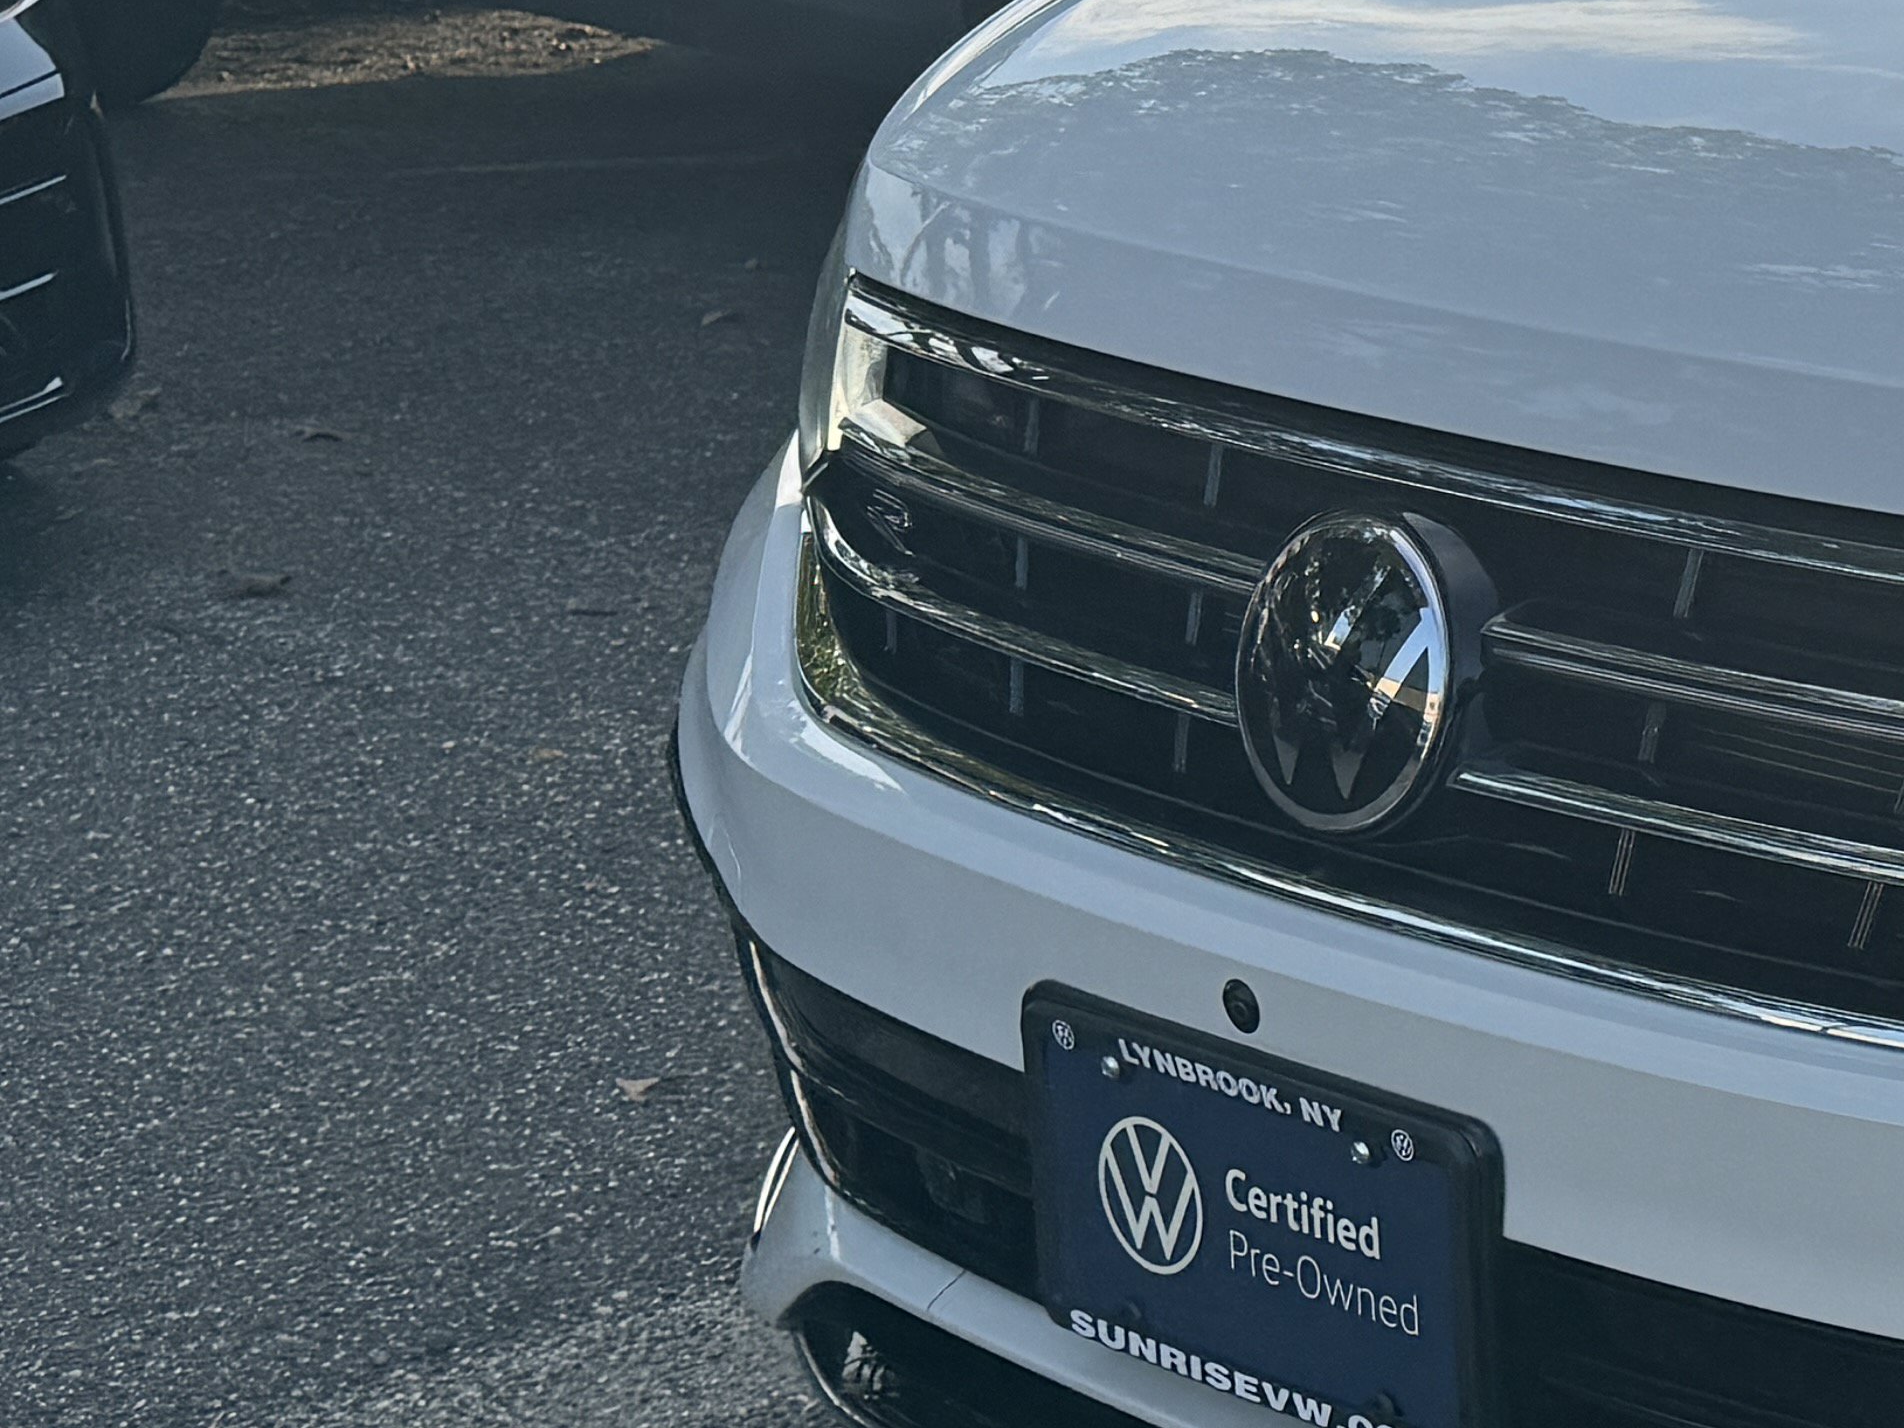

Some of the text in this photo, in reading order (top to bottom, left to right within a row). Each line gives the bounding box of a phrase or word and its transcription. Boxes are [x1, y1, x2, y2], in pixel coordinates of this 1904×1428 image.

[1237, 510, 1452, 832] VW
[1118, 1038, 1345, 1134] LYNBROOK, NY
[1099, 1115, 1203, 1275] VW
[1225, 1168, 1381, 1260] Certified
[1229, 1229, 1420, 1337] Pre-Owned
